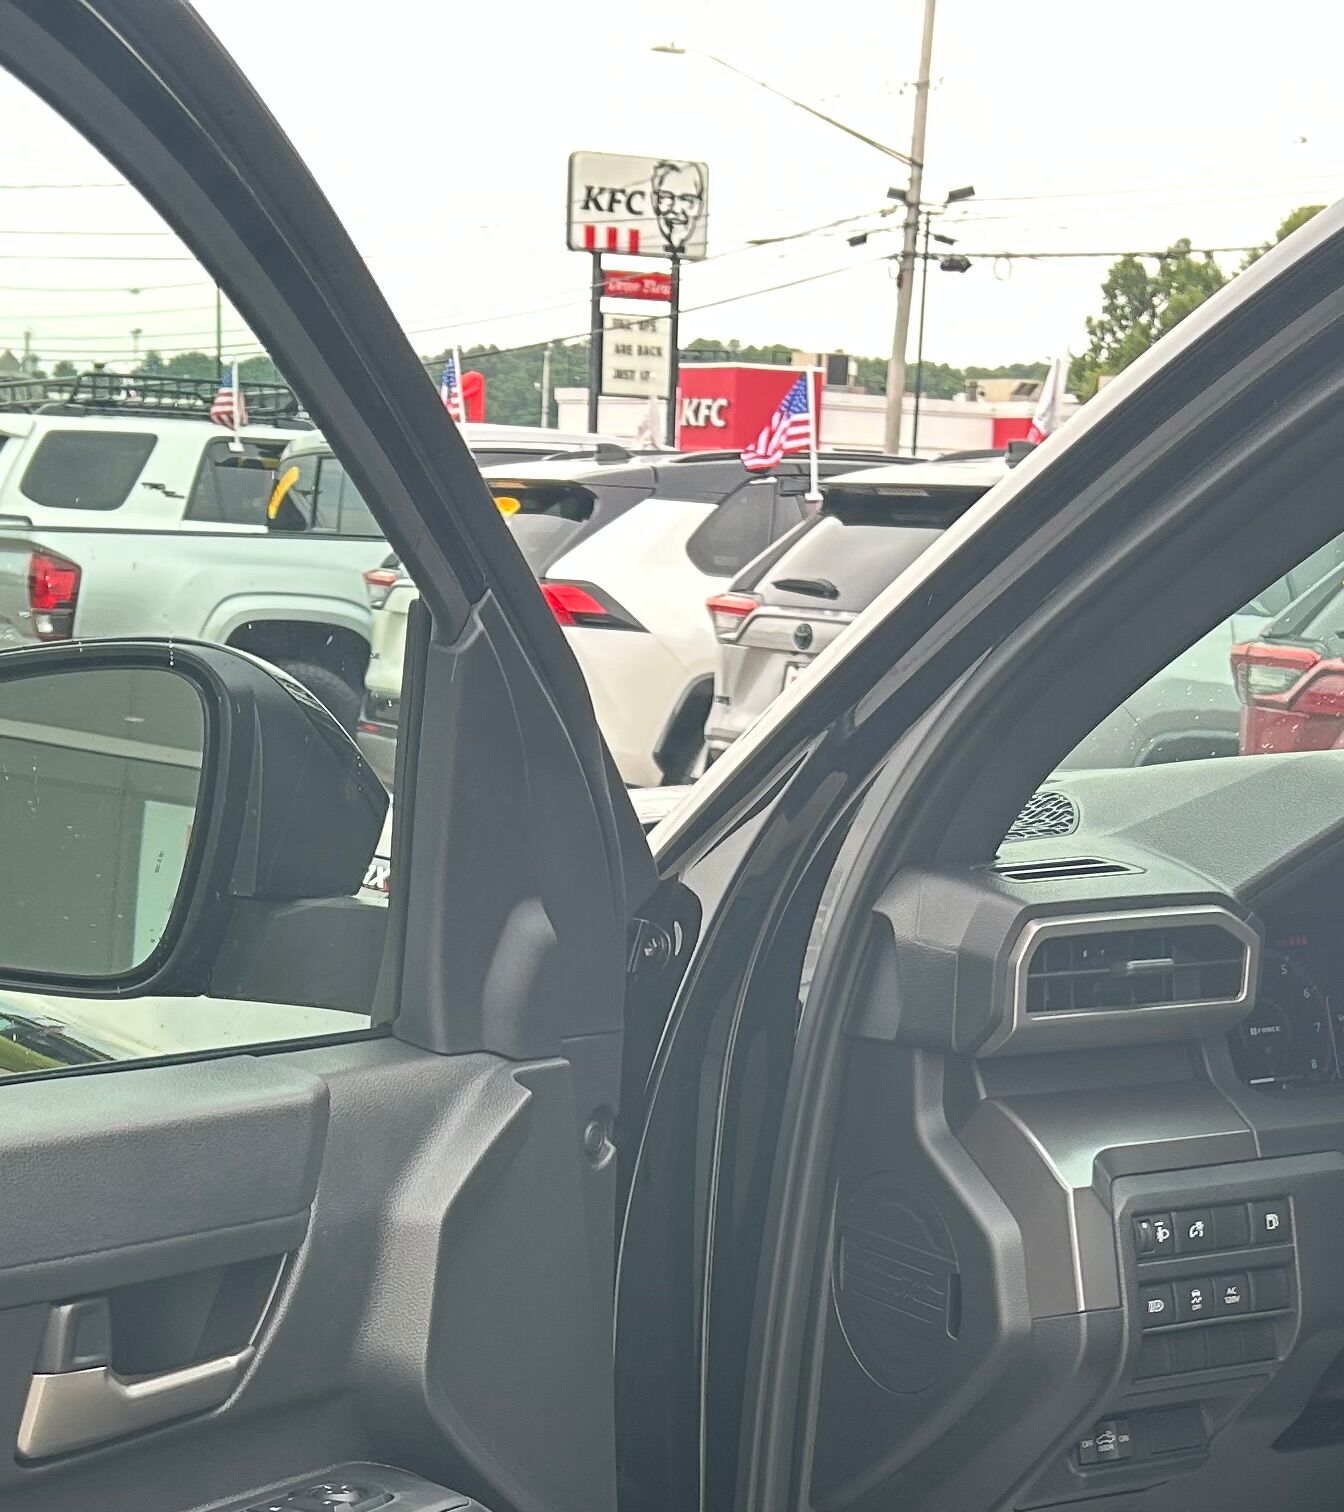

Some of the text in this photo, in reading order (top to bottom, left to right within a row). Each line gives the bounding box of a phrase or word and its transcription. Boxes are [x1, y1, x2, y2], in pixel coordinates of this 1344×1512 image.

[581, 185, 645, 215] KFC
[637, 344, 663, 357] BACK
[681, 397, 728, 427] KFC
